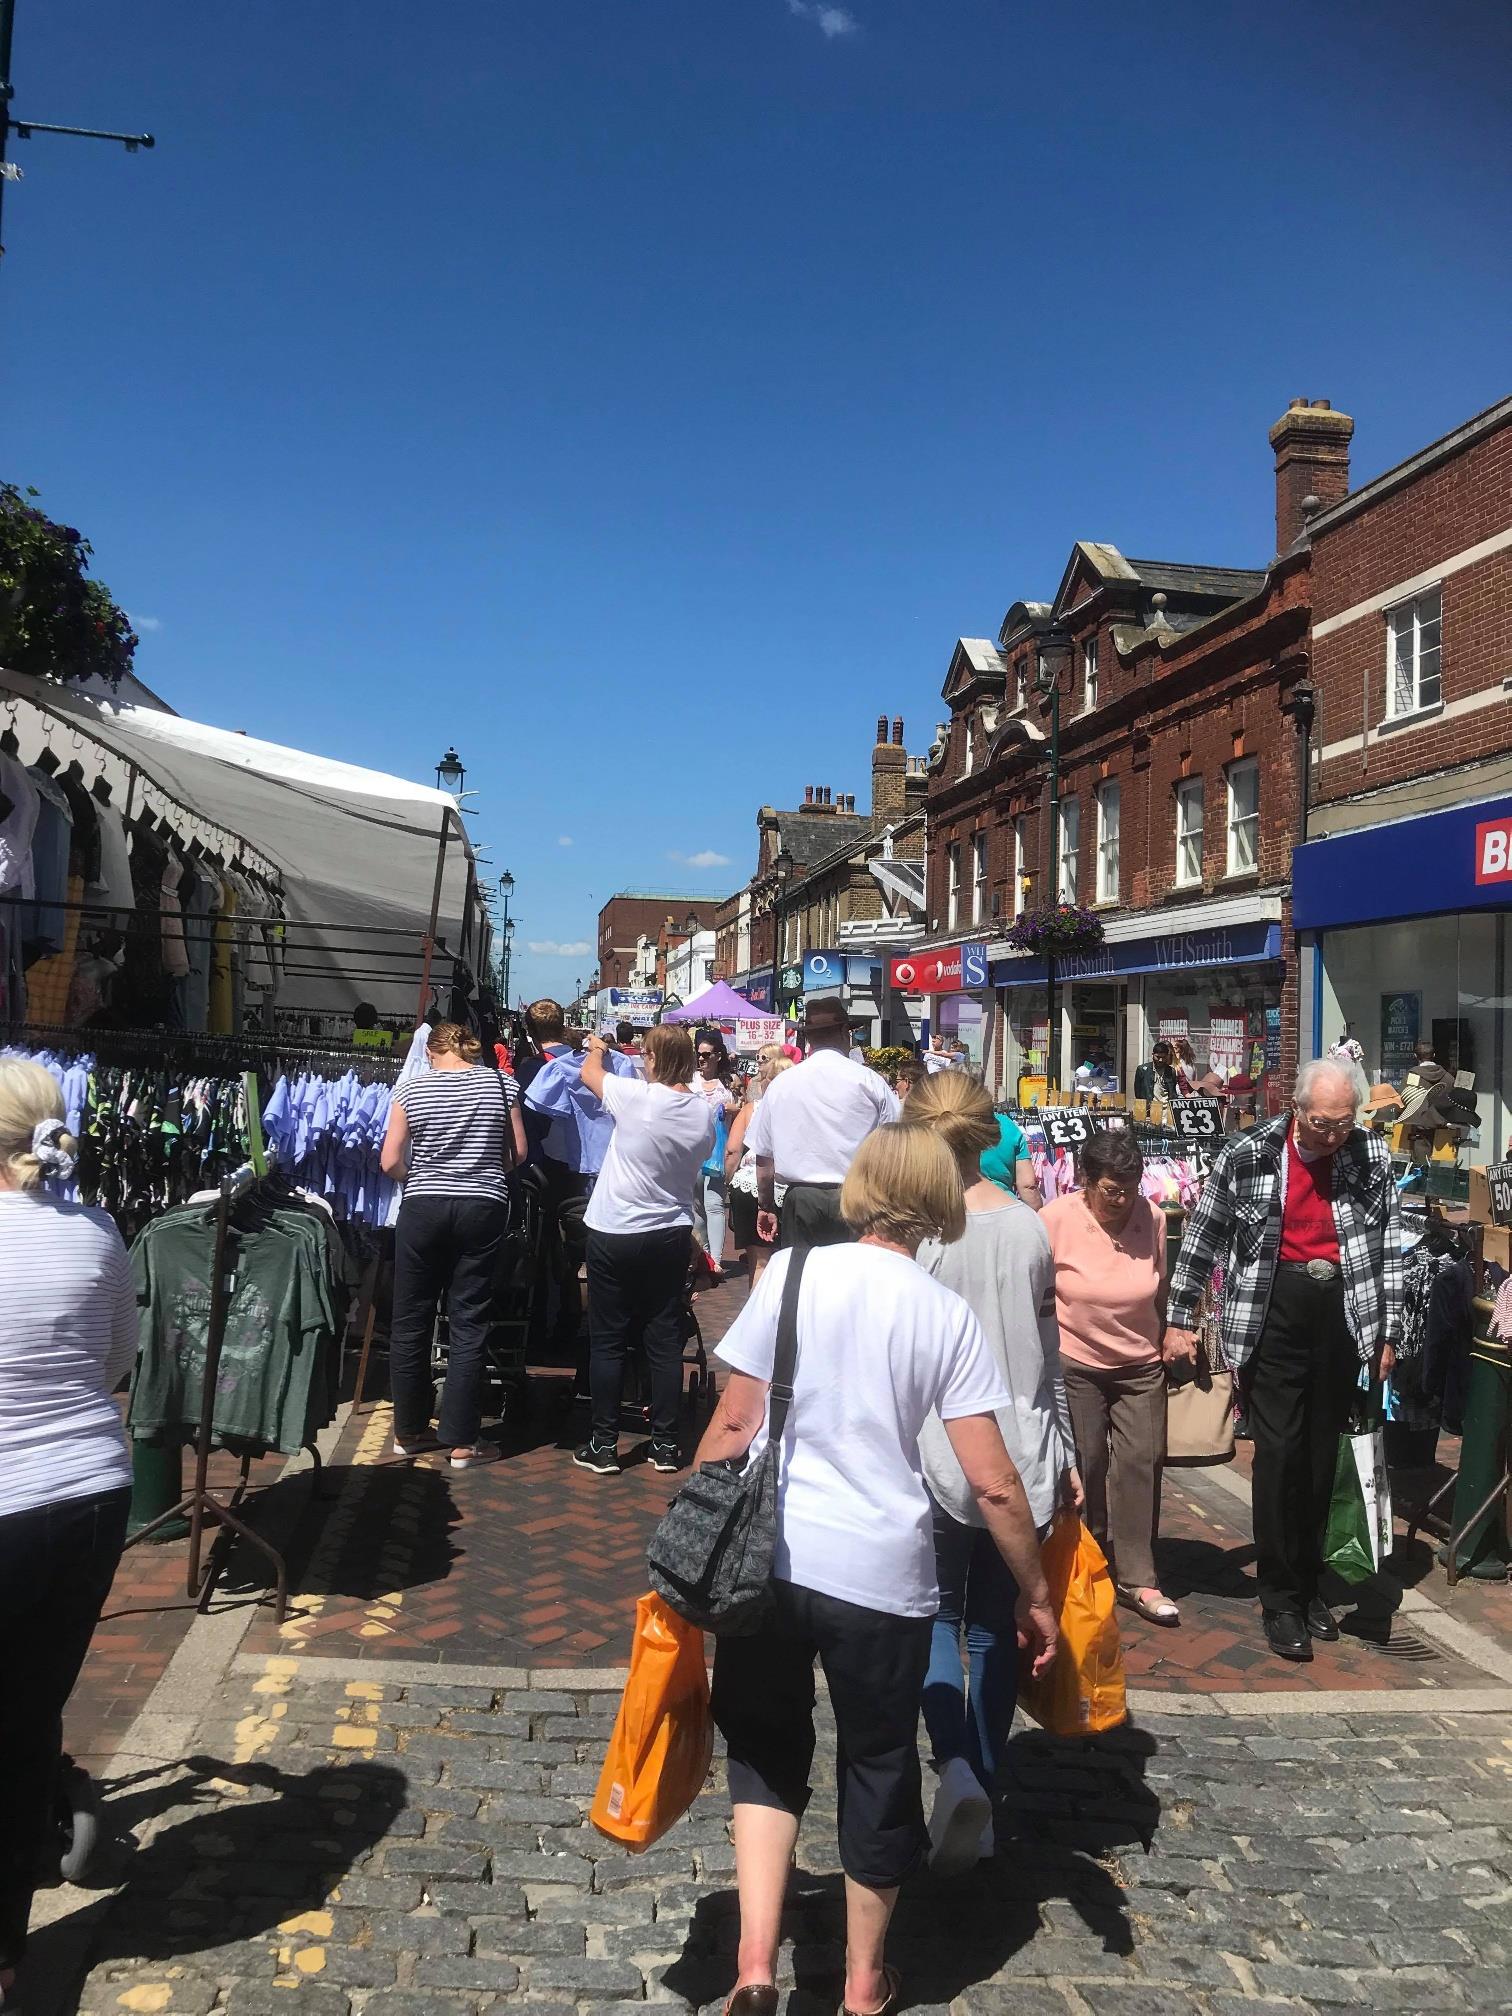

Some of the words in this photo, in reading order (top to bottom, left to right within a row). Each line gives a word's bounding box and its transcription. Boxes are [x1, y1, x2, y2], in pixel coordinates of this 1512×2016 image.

[1482, 830, 1512, 874] B
[966, 946, 985, 956] WH
[1154, 931, 1234, 967] WHSmith
[966, 955, 985, 985] S
[1058, 948, 1115, 979] WHSmith
[740, 1021, 761, 1030] PLUS
[763, 1020, 781, 1030] SIZE
[1159, 1019, 1188, 1036] SUMMER
[1210, 1018, 1244, 1037] SUMMER
[748, 1030, 757, 1040] 16
[764, 1030, 775, 1040] 32
[1172, 1100, 1192, 1109] ANY
[1193, 1099, 1218, 1109] ITEM
[1042, 1111, 1063, 1122] ANY
[1063, 1107, 1088, 1119] ITEM
[1180, 1109, 1216, 1134] £3
[1050, 1118, 1087, 1143] £3
[1489, 1168, 1502, 1181] ANY
[1502, 1165, 1512, 1179] ITE
[1494, 1181, 1512, 1211] 50
